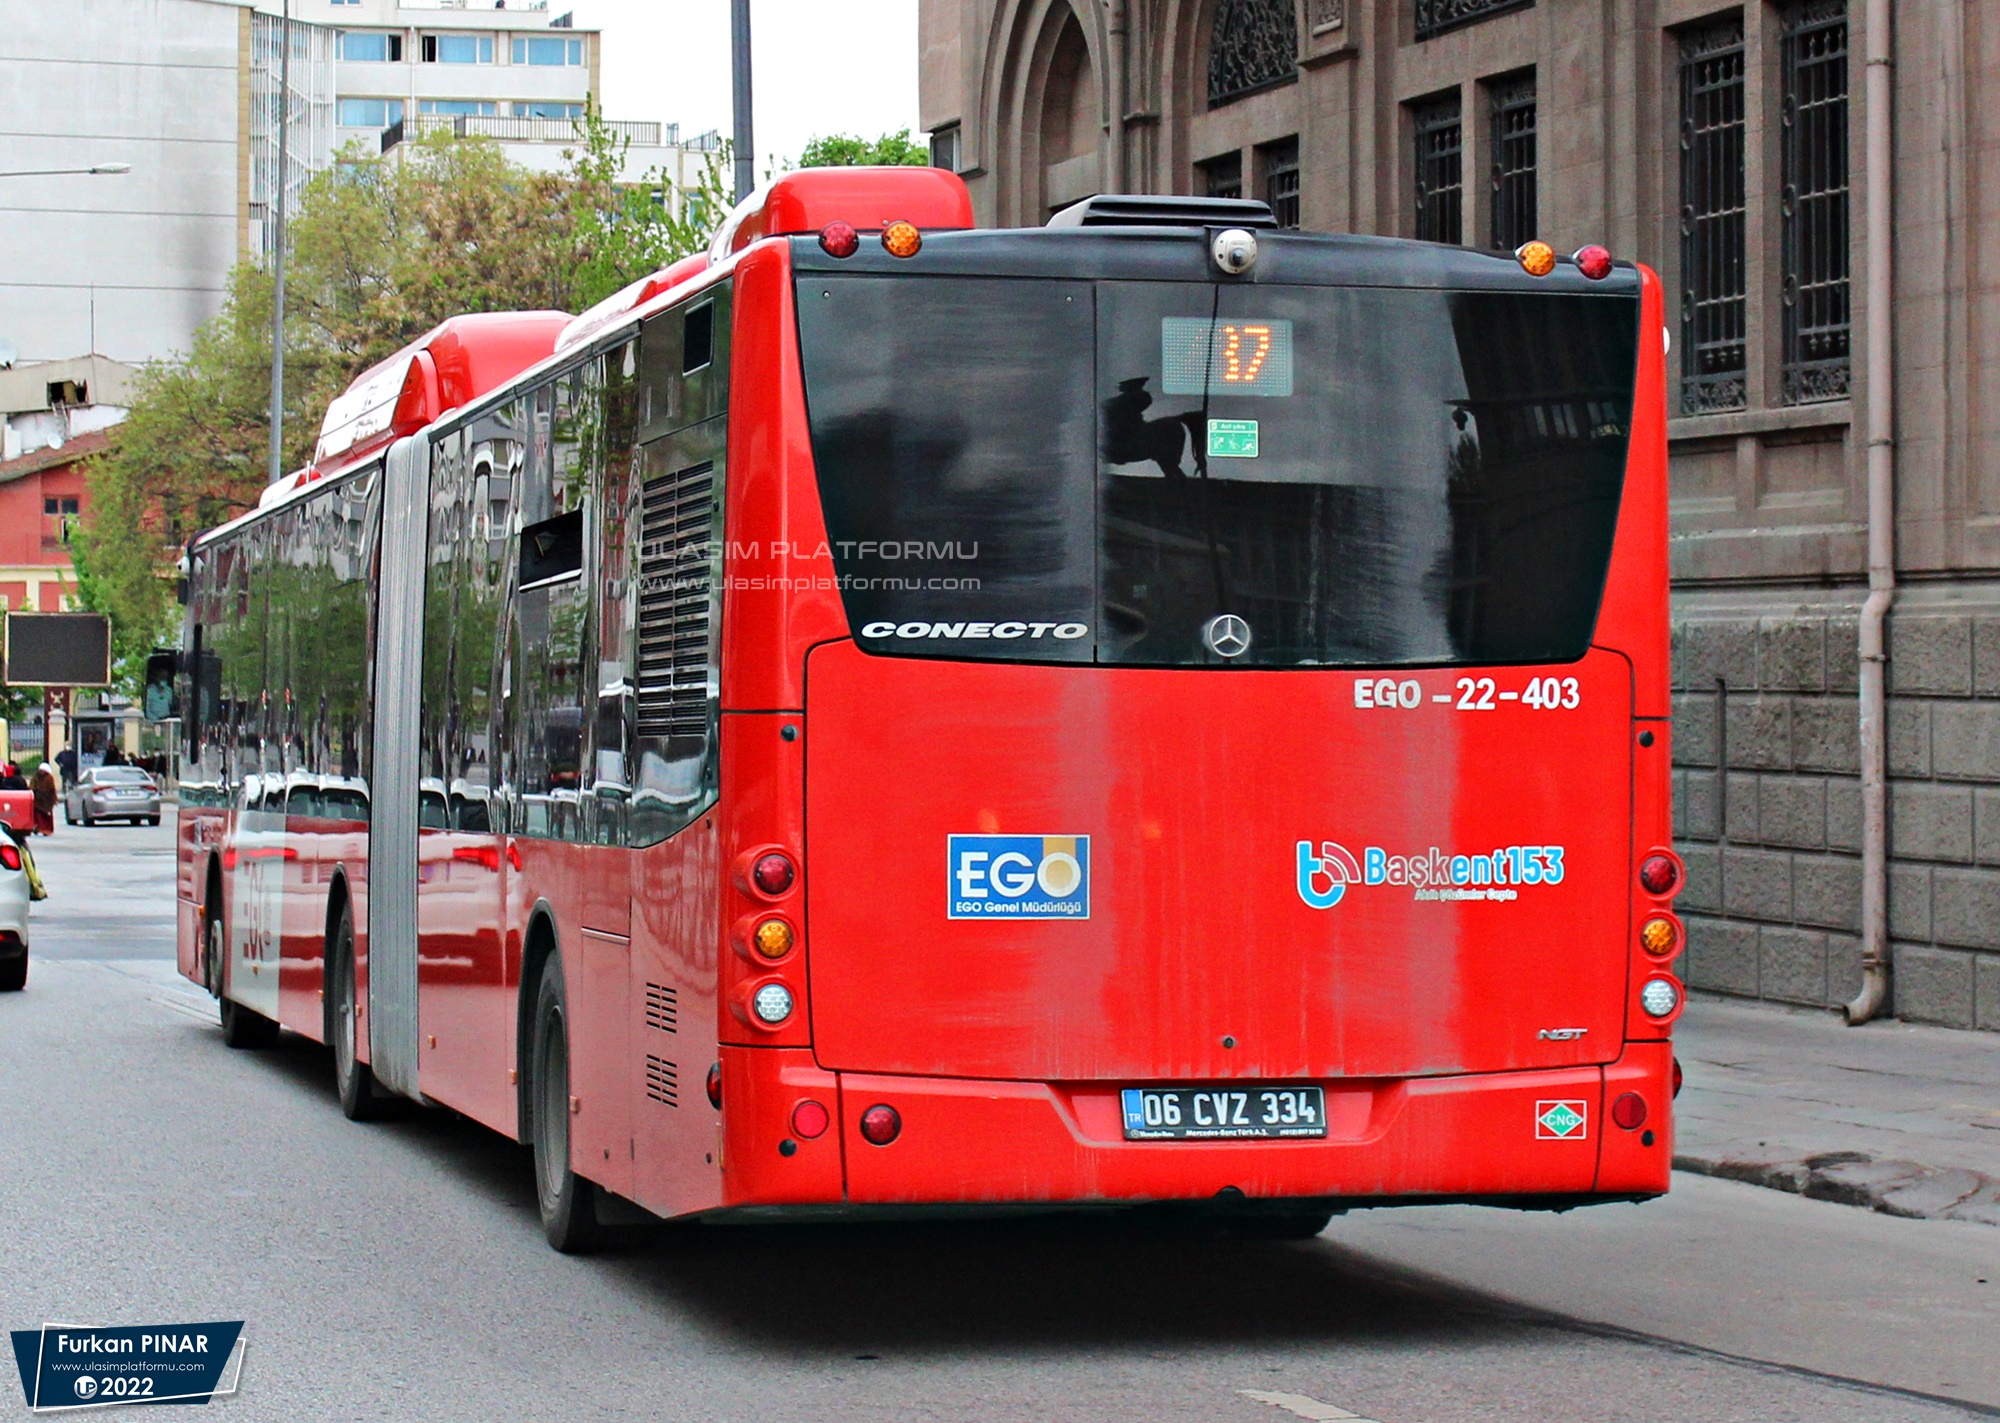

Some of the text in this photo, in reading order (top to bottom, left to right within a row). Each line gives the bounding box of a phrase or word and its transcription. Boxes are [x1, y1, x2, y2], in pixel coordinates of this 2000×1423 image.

[861, 621, 1089, 640] CONECTO
[1353, 678, 1422, 709] EGO
[956, 851, 1082, 899] EGO
[1364, 846, 1565, 888] Başkent153
[955, 901, 1082, 915] EGO Genel Müdürlüğü
[1537, 1028, 1588, 1041] NGT
[1128, 1091, 1316, 1126] TR 06 CVZ 334
[1546, 1114, 1576, 1127] CNG
